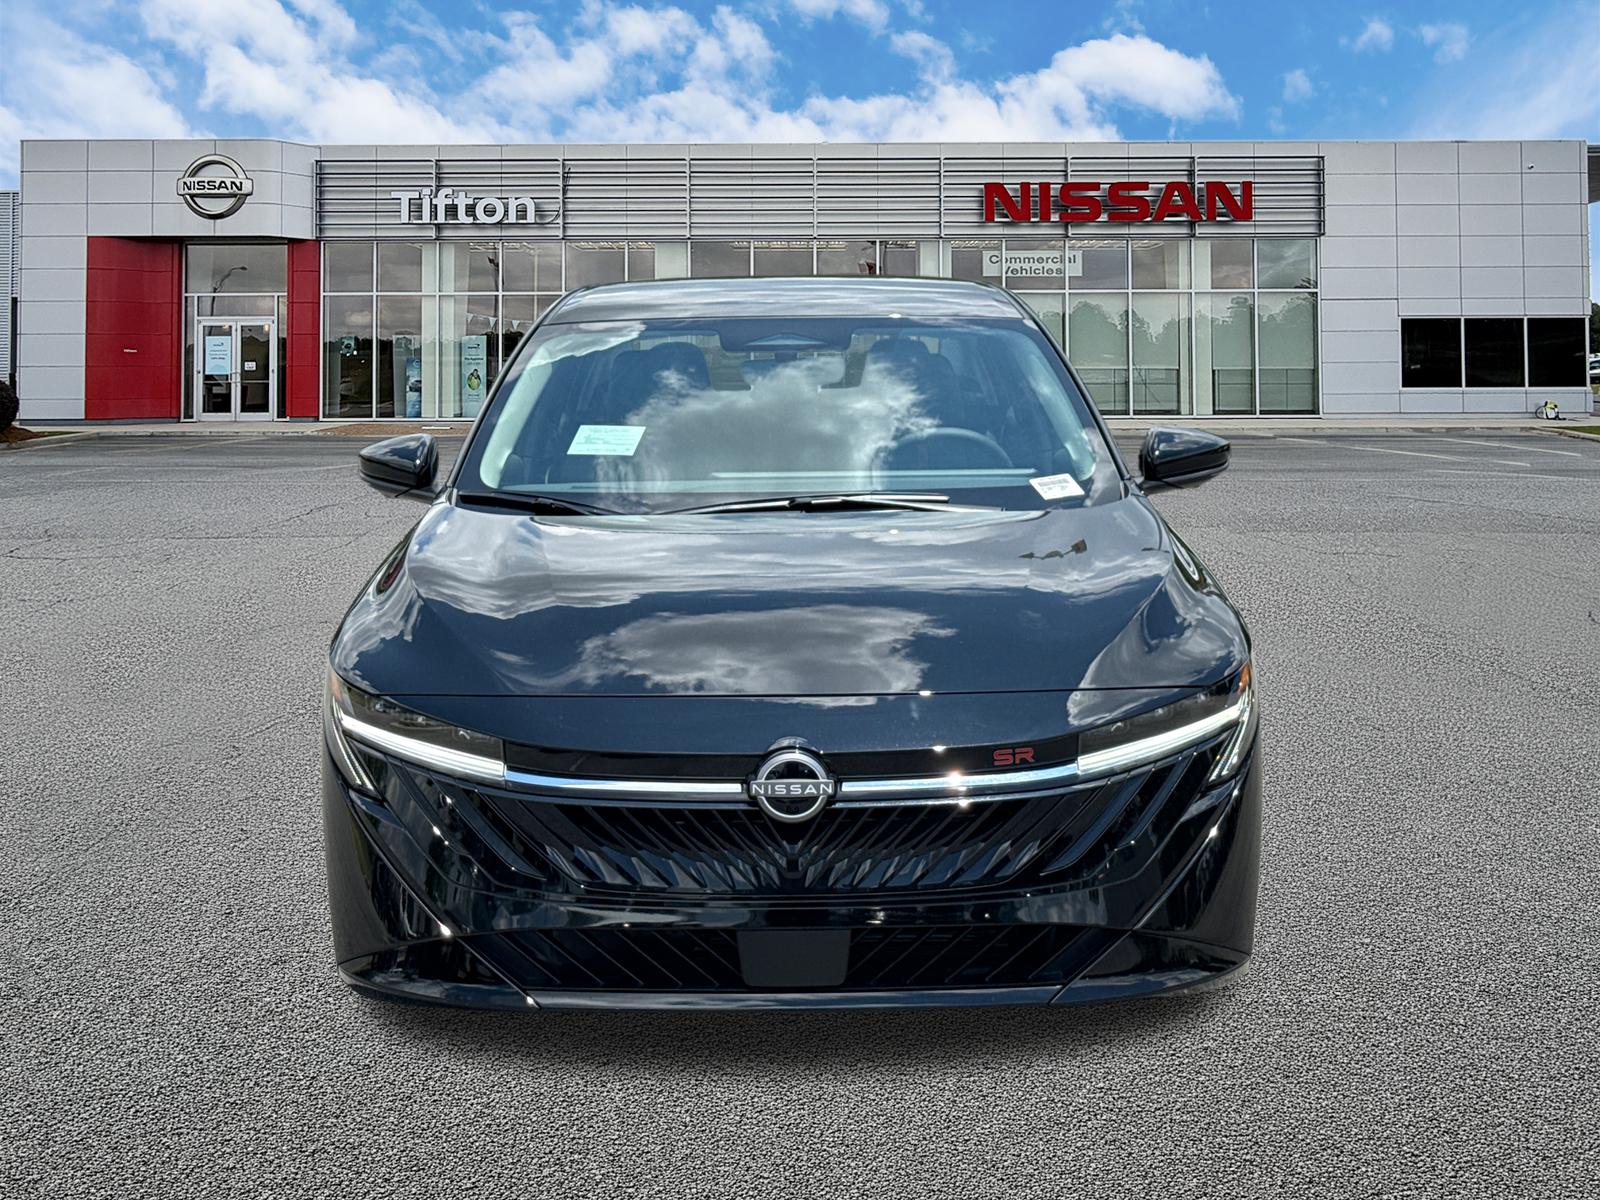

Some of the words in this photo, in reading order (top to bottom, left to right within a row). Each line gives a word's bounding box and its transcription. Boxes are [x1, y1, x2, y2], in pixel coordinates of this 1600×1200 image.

[183, 181, 243, 192] NISSAN
[391, 188, 536, 224] Tifton
[984, 181, 1253, 222] NISSAN
[993, 747, 1036, 766] SR
[752, 783, 832, 795] NISSAN
